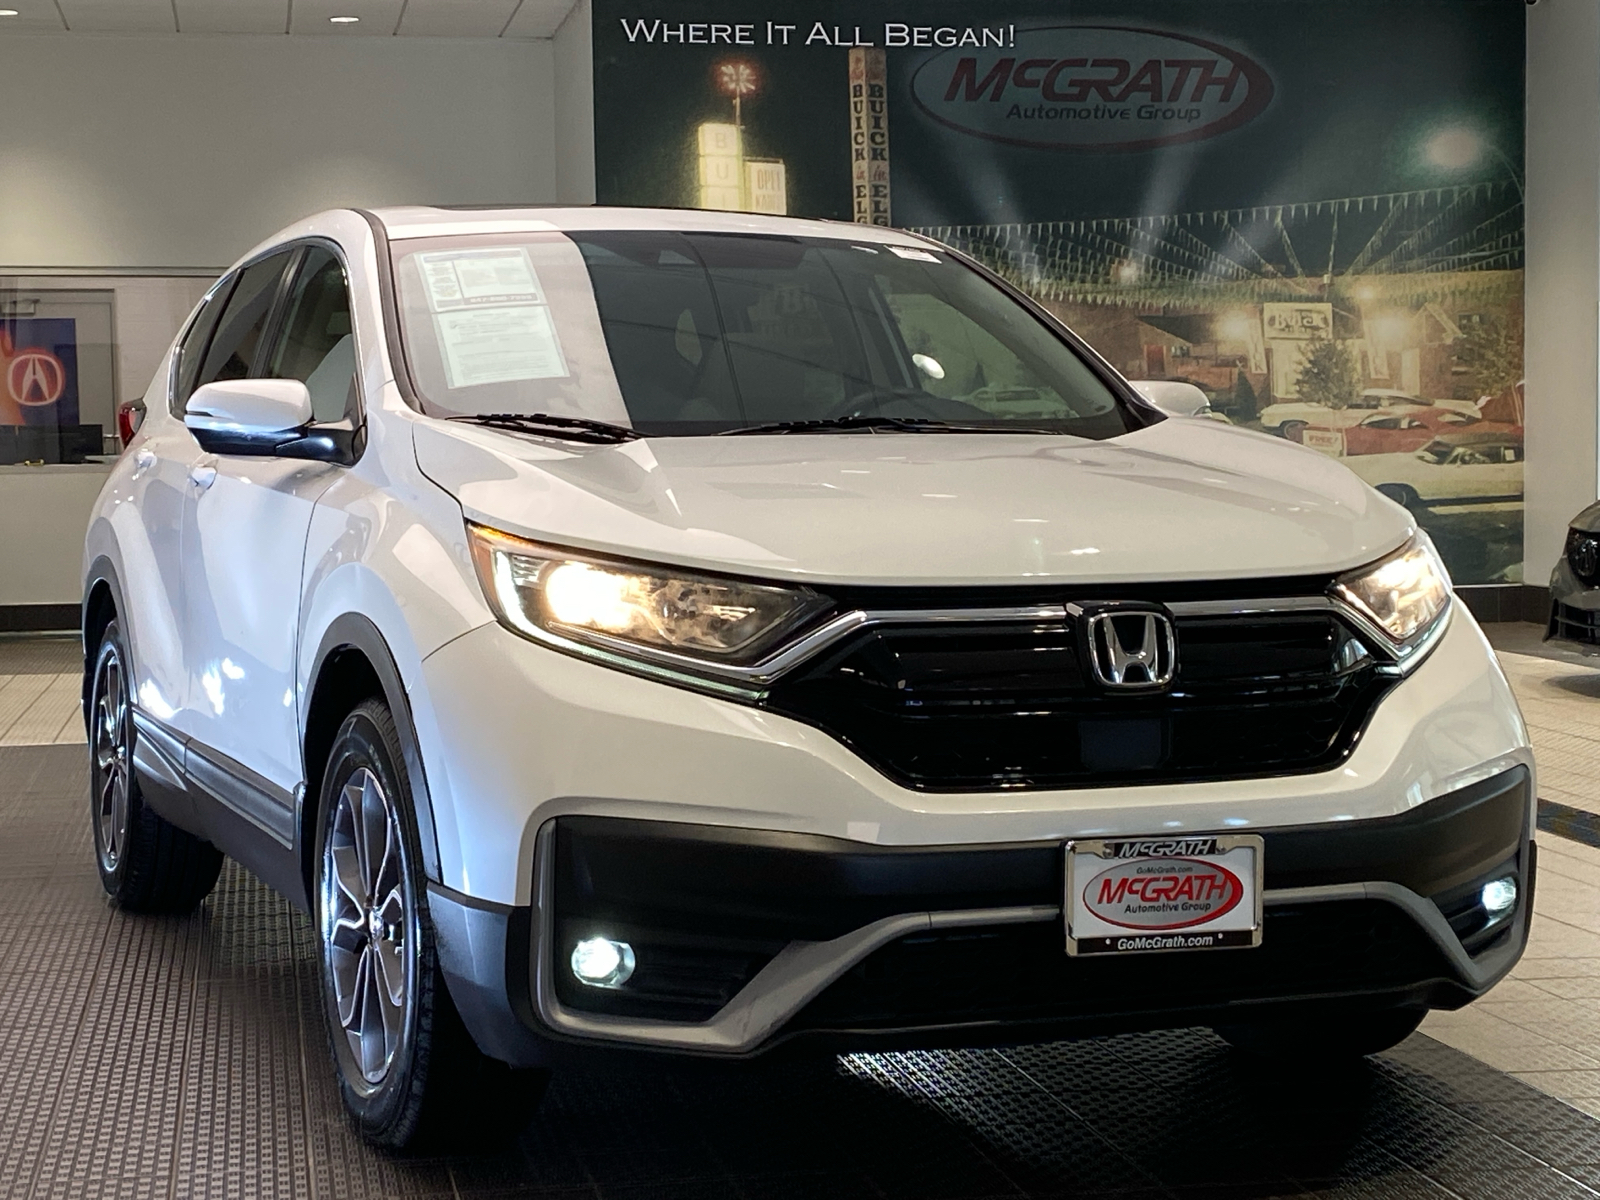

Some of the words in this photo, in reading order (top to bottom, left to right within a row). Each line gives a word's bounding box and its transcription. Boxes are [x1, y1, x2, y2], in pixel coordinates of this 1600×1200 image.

[620, 18, 755, 45] WHERE
[765, 20, 797, 45] IT
[804, 21, 875, 48] ALL
[884, 23, 1017, 49] BEGAN!
[852, 84, 866, 162] BUICK
[868, 83, 887, 161] BUICK
[1005, 103, 1132, 121] Automotive
[1136, 105, 1201, 123] Group
[1136, 866, 1193, 875] GoMcGrath.com
[1124, 904, 1180, 914] Automotive
[1181, 901, 1211, 913] Group
[1117, 936, 1213, 950] GoMcGrath.com
